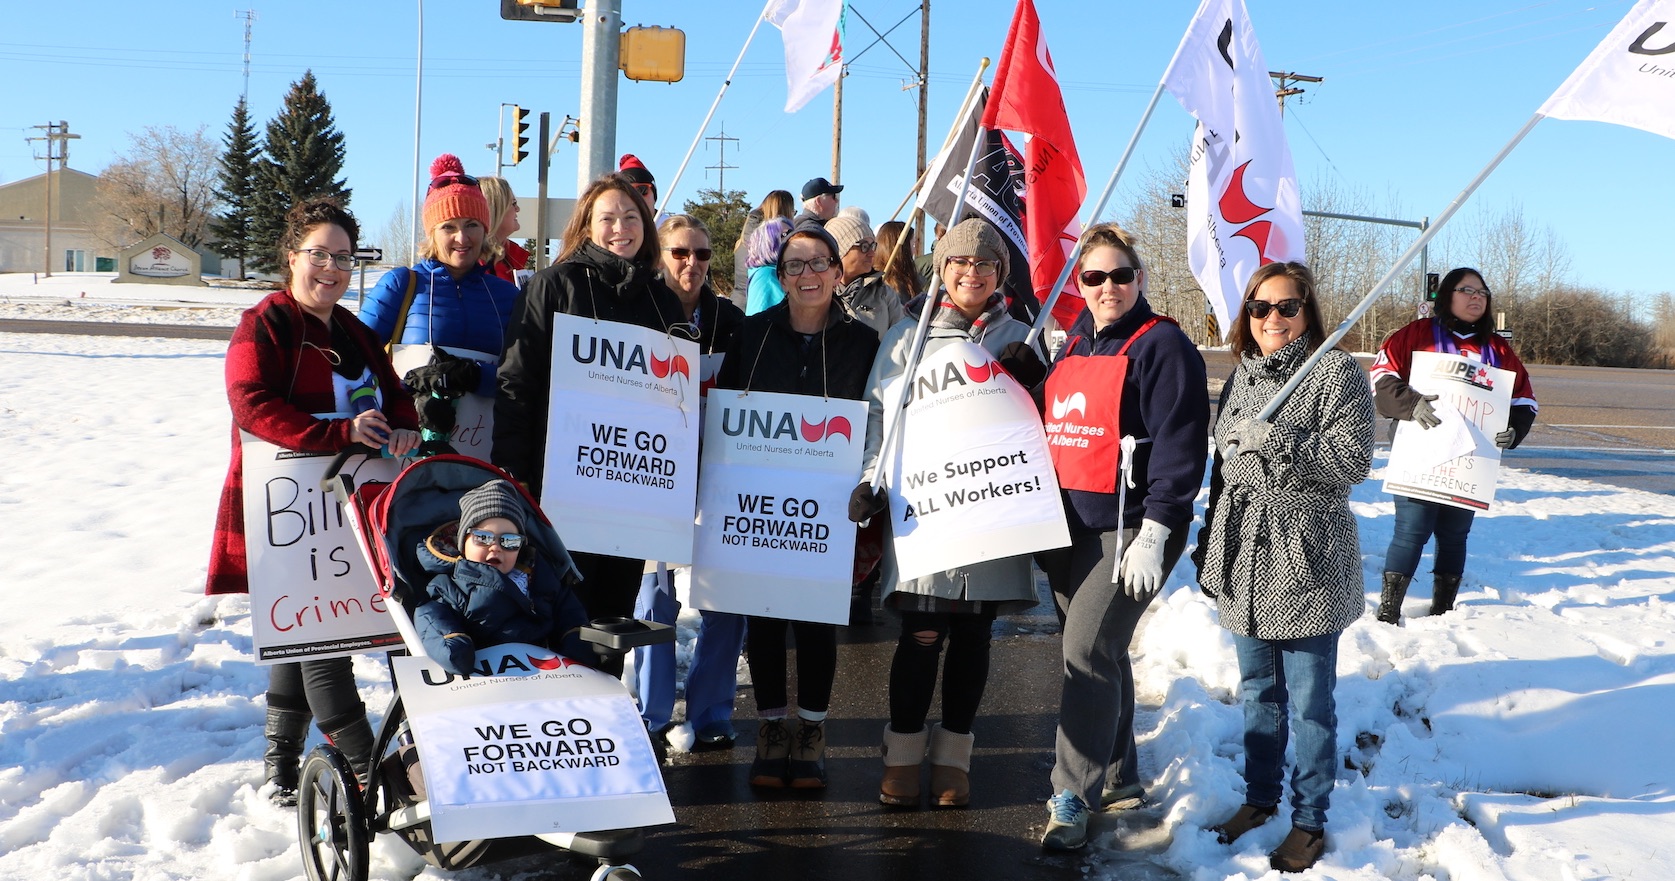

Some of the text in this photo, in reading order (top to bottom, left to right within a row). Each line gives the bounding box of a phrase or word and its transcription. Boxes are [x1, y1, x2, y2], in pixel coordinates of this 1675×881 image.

[953, 178, 978, 202] Alrta
[978, 196, 999, 217] Union
[998, 215, 1008, 225] of
[1207, 214, 1227, 270] Alberta
[572, 334, 648, 375] UNA
[1433, 360, 1476, 379] AUPE
[588, 370, 678, 396] United Nurses of Alberta
[910, 387, 1007, 416] United Nurses of Alberta
[722, 407, 799, 441] UNA
[1045, 421, 1104, 437] ited Nurses
[591, 423, 627, 447] WE
[634, 430, 667, 454] GO
[736, 442, 834, 458] United Nurses of Alberta
[1051, 434, 1089, 448] Alberta
[577, 445, 676, 477] FORWARD
[906, 450, 1028, 490] We Support
[576, 464, 675, 490] NOT BACKWARD
[1403, 470, 1477, 494] DIFFERENCE
[737, 493, 819, 519] WE GO
[903, 475, 1042, 522] ALL Workers!
[723, 515, 830, 540] FORWARD
[722, 534, 828, 554] NOT BACKWARD
[310, 546, 350, 580] is
[270, 593, 387, 632] Crime
[263, 649, 285, 657] Alberta
[310, 643, 340, 652] Provincial
[340, 641, 372, 649] Employees.
[450, 680, 487, 692] United
[489, 676, 529, 685] Nurses
[545, 672, 583, 680] Alberta
[474, 718, 593, 742] WE GO
[463, 737, 616, 763] FORWARD
[467, 755, 620, 775] NOT BACKWARD
